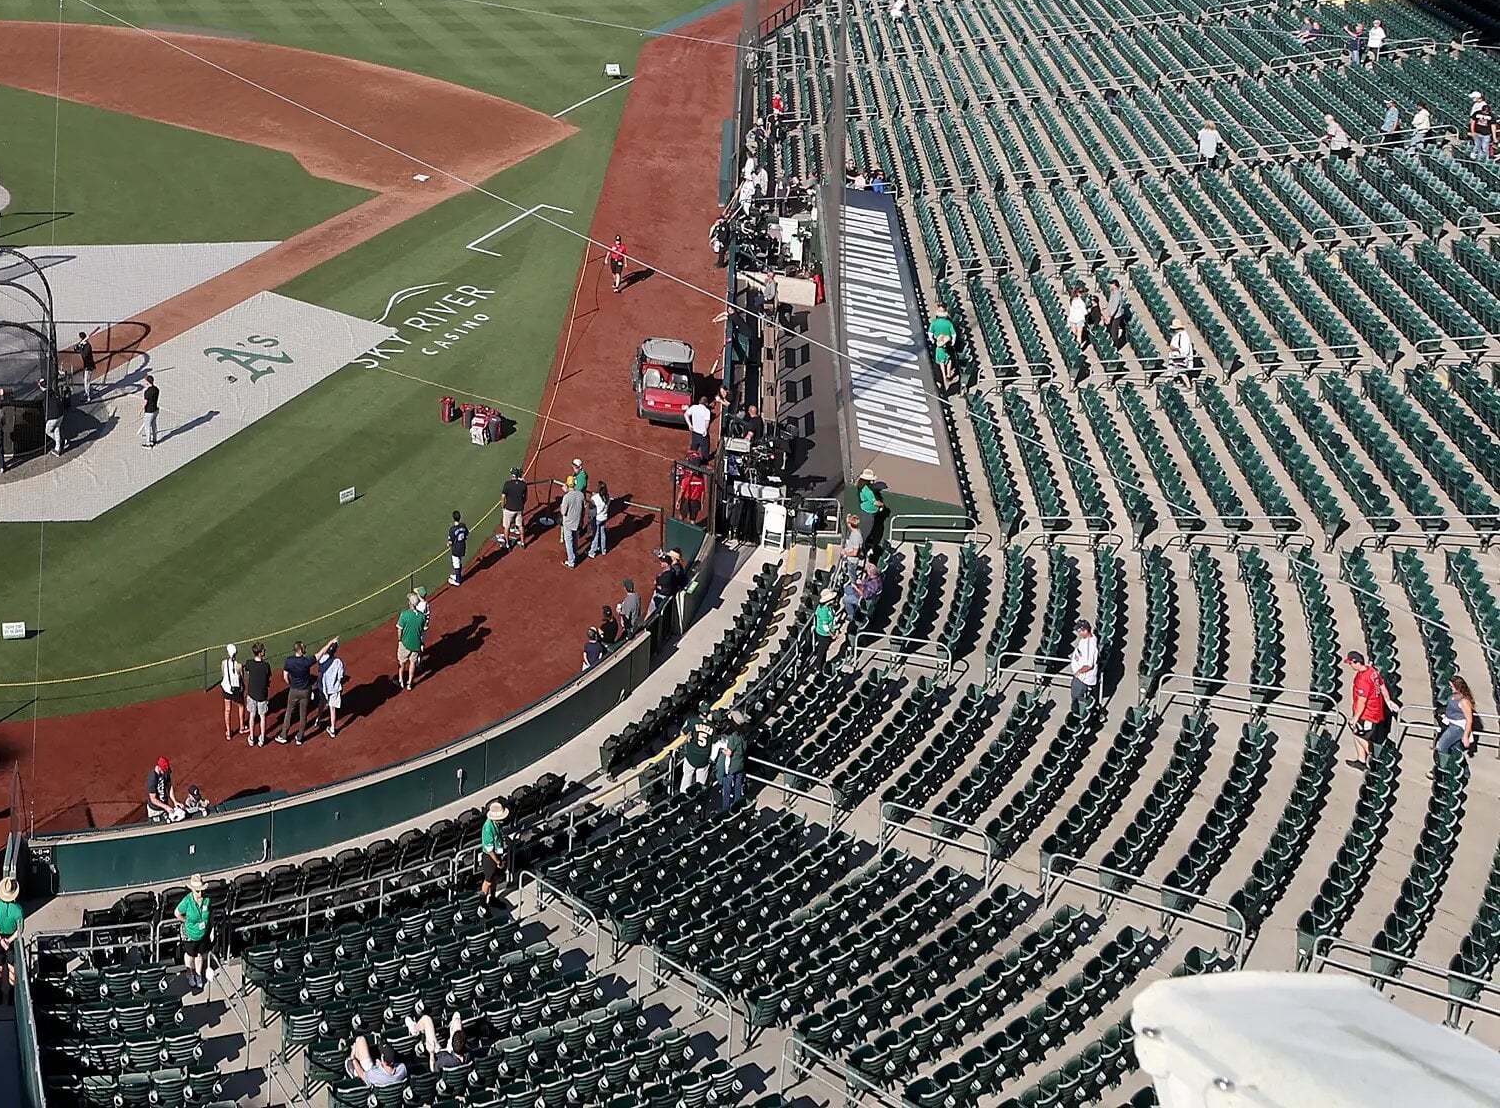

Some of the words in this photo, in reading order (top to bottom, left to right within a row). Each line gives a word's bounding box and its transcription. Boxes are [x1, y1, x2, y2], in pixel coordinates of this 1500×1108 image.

[839, 204, 891, 240] PARK
[841, 235, 902, 288] HEALTH
[350, 334, 412, 369] SKY
[403, 284, 495, 332] RIVER
[422, 313, 490, 356] CASINO
[844, 282, 915, 346] SUTTER
[203, 335, 294, 384] A's
[848, 339, 920, 370] TO
[851, 364, 940, 465] WELCOME
